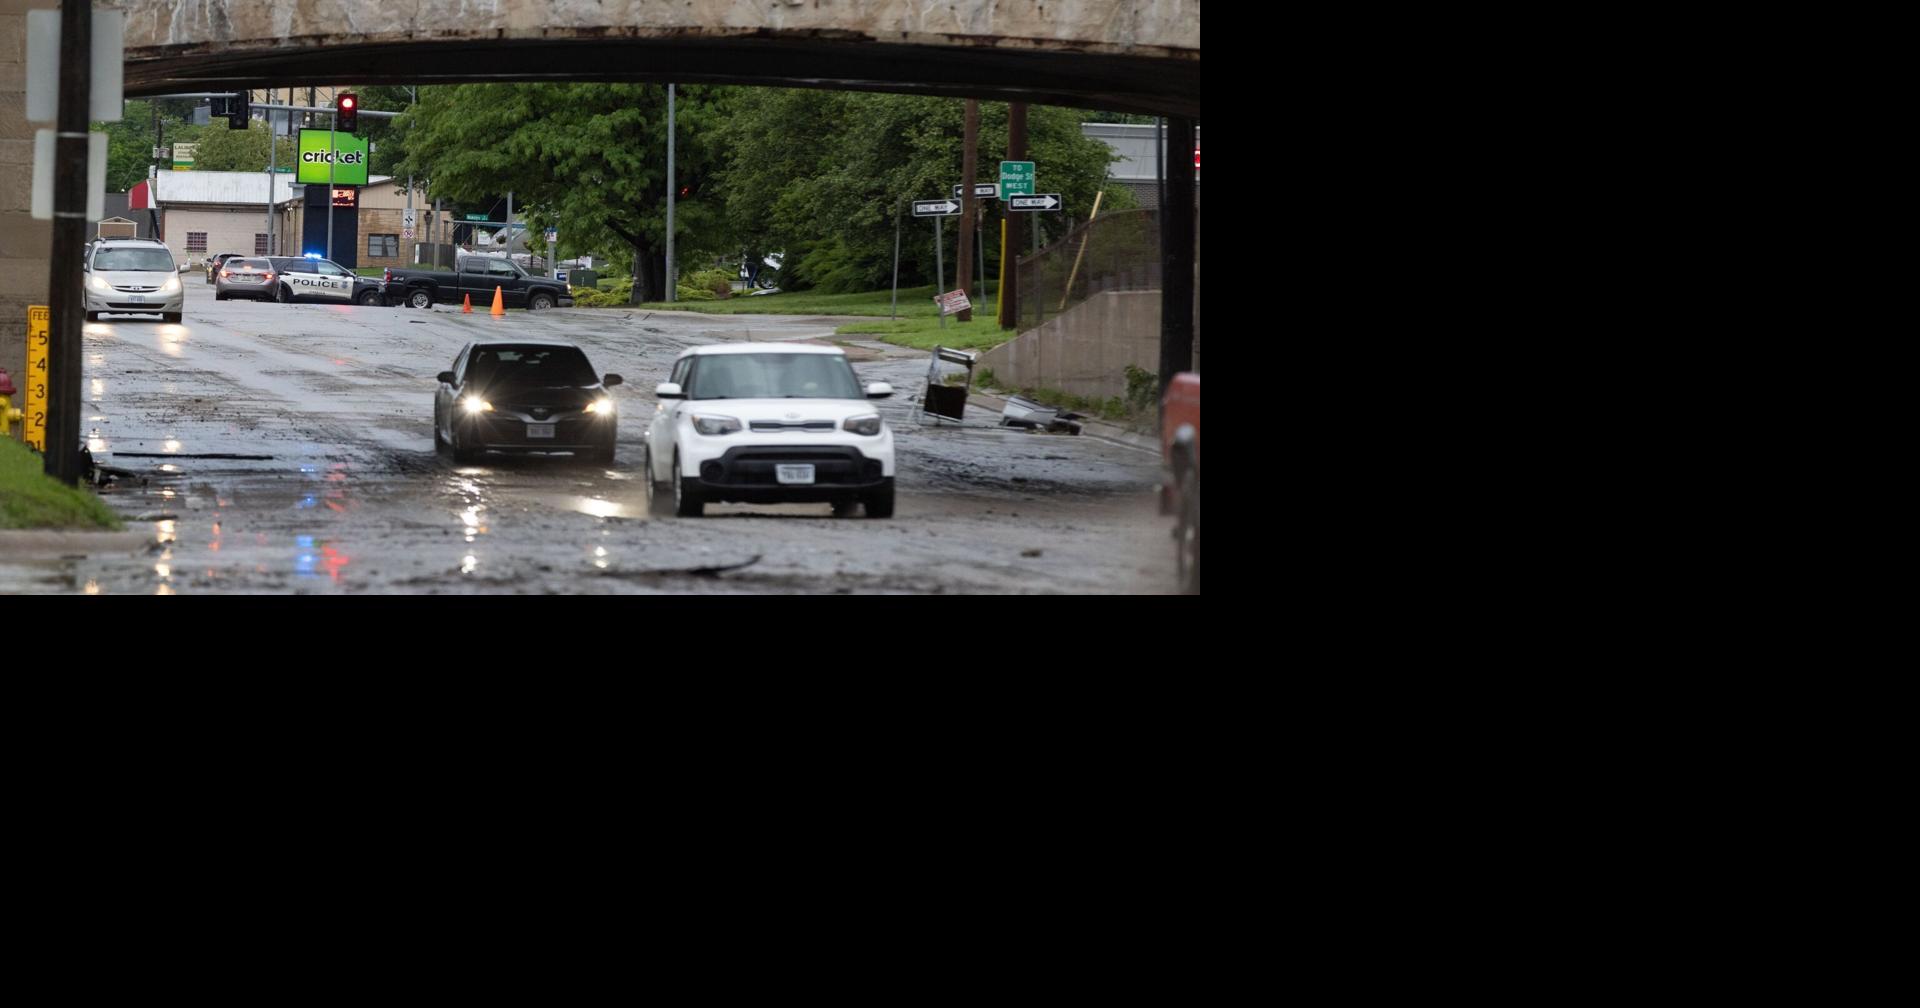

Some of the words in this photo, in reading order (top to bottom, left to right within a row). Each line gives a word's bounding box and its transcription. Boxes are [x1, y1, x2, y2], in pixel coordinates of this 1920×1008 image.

[302, 149, 362, 164] cricket
[1002, 172, 1024, 182] Dodge
[293, 278, 338, 288] POLICE
[33, 311, 49, 320] FEE
[39, 331, 48, 345] 5
[36, 357, 46, 371] 4
[35, 384, 45, 398] 3
[35, 411, 44, 426] 2
